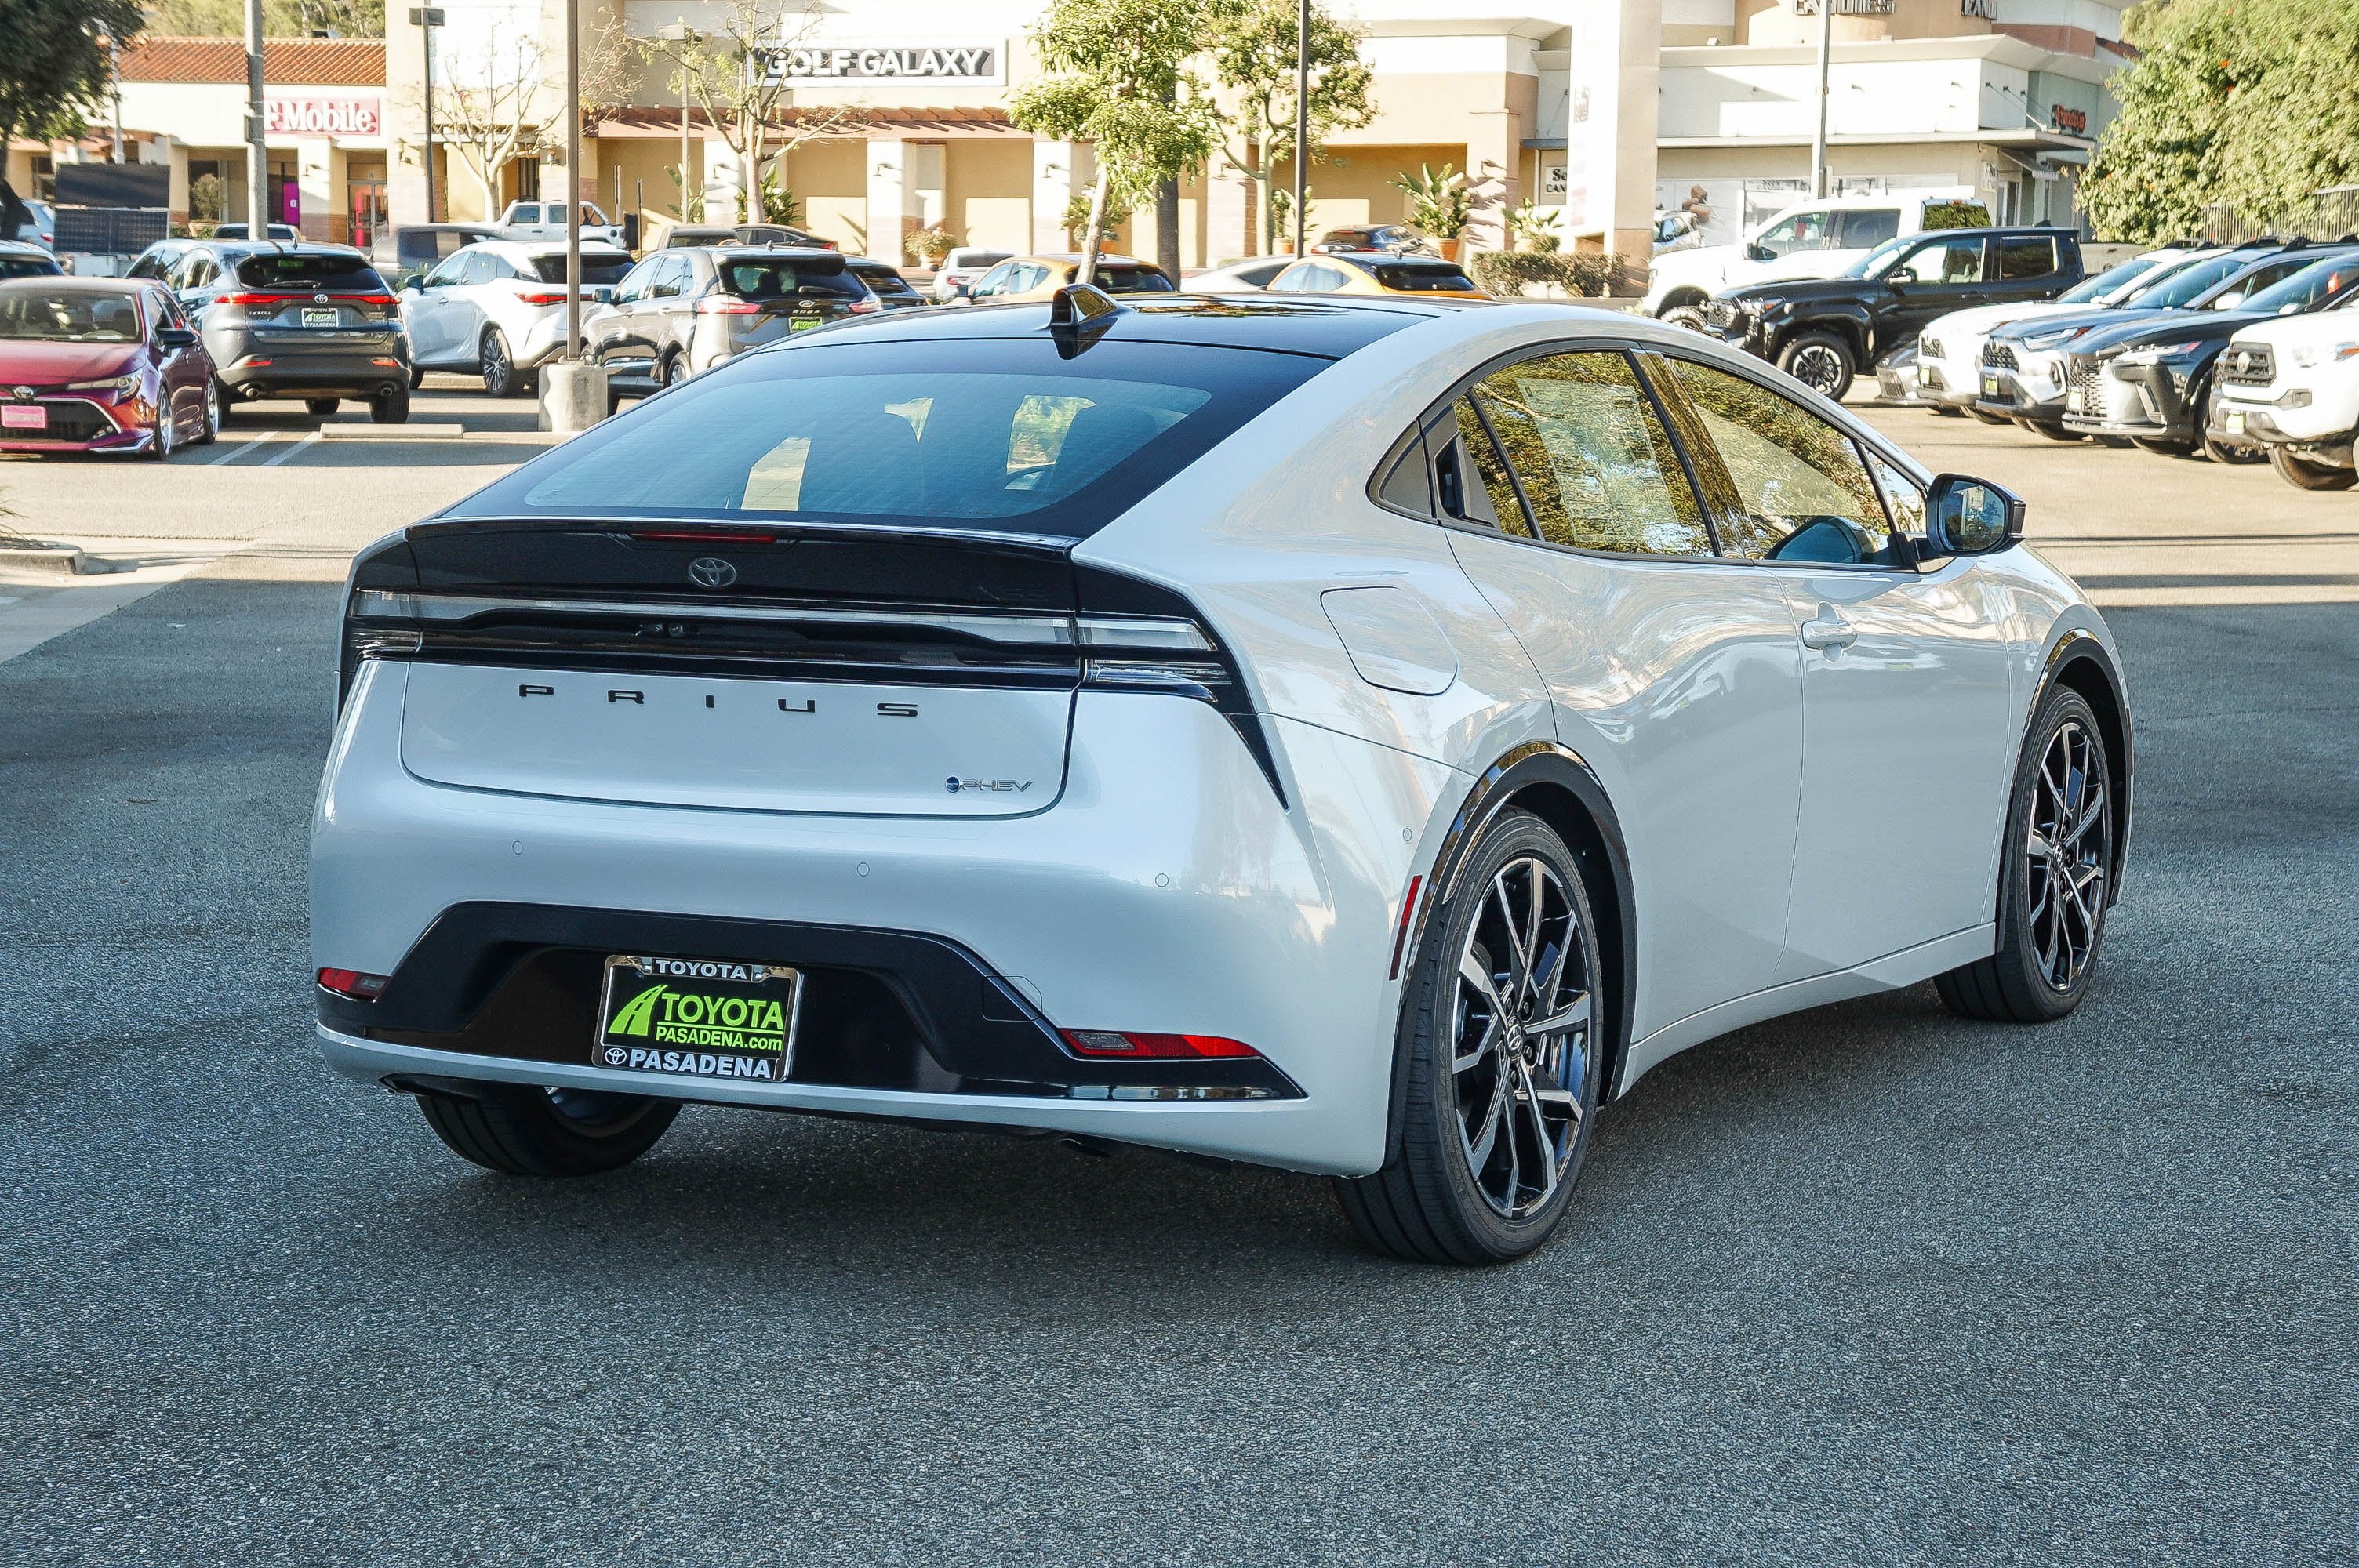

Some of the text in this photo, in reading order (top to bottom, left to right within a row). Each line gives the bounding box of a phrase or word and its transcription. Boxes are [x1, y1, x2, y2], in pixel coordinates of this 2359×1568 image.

[767, 48, 985, 77] GOLF GALAXY
[519, 684, 918, 717] PRIUS
[961, 778, 1034, 793] PHEV
[656, 960, 747, 979] TOYOTA
[661, 993, 784, 1030] TOYOTA
[656, 1026, 783, 1051] PASADENA.com
[629, 1048, 771, 1079] PASADENA
